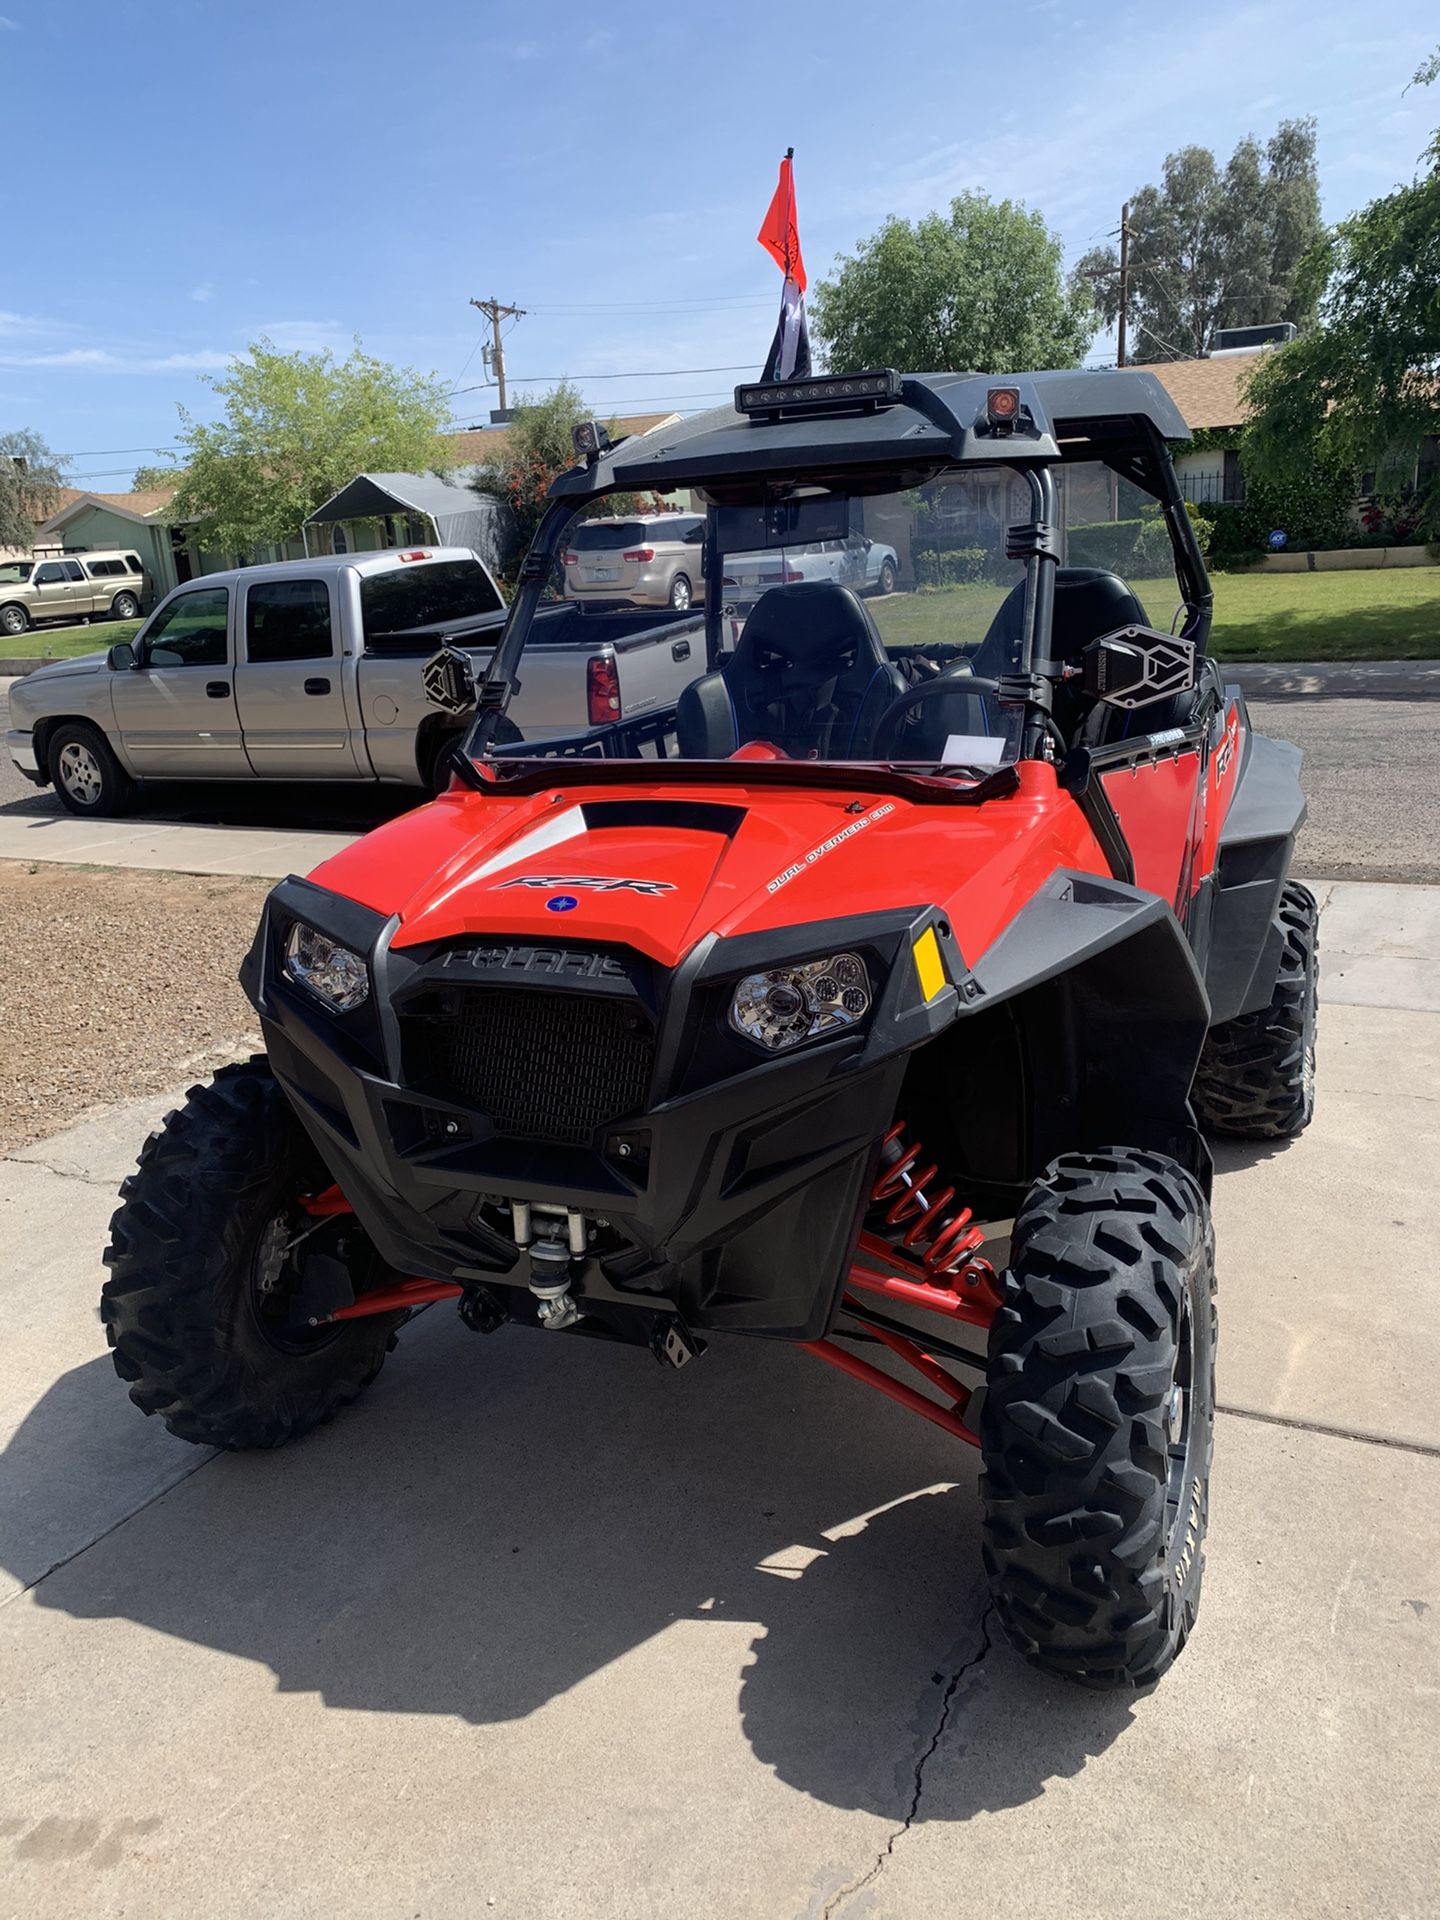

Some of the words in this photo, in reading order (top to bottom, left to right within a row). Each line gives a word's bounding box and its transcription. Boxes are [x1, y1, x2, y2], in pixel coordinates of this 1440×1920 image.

[767, 863, 806, 893] DUAL
[805, 817, 870, 863] OVERHEAD
[869, 803, 895, 820] CAM
[488, 875, 678, 897] RZR
[442, 946, 627, 979] POLARIS
[1175, 1476, 1201, 1588] MAXXIS
